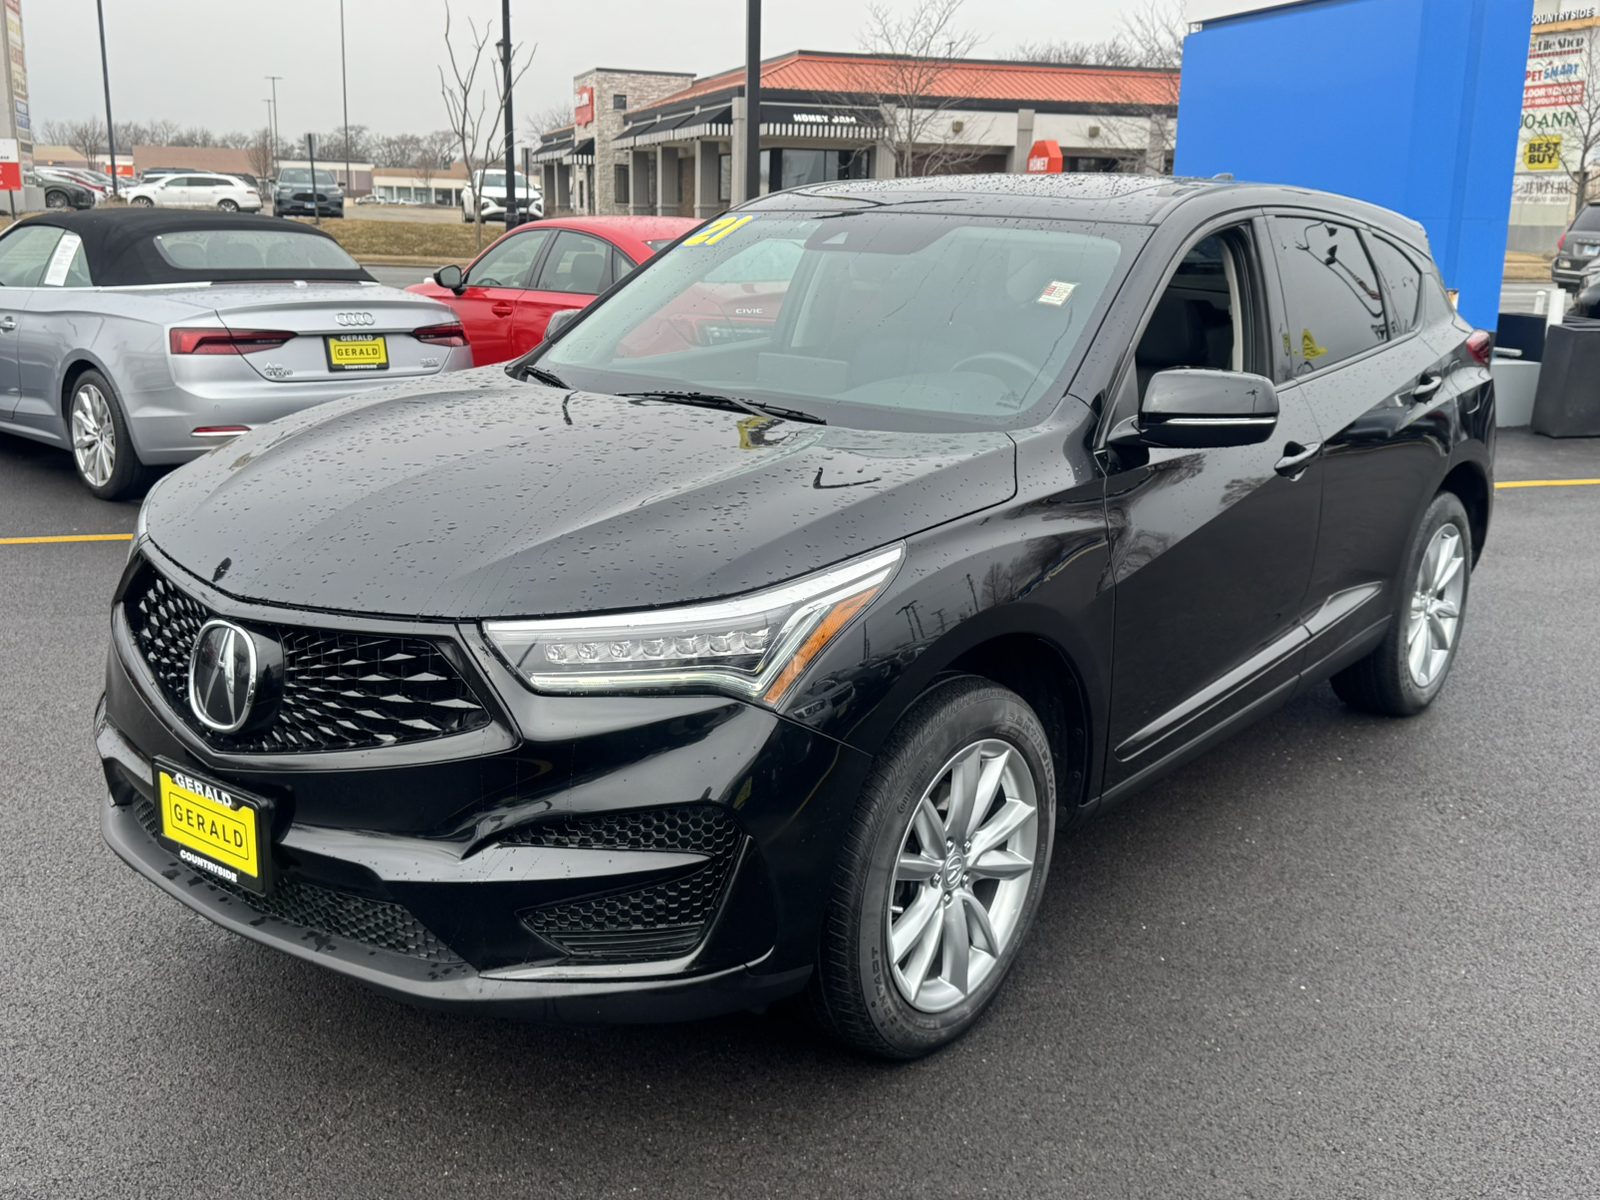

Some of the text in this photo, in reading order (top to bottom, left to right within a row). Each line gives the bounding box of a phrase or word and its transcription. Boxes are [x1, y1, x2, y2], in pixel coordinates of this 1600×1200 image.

[1557, 37, 1584, 50] Shop
[1523, 87, 1547, 99] LOOR
[793, 113, 829, 124] HONEY
[1528, 142, 1561, 153] BEST
[1528, 152, 1556, 164] BUY
[340, 334, 373, 342] GERALD
[337, 347, 379, 357] GERALD
[174, 772, 232, 807] GERALD
[173, 803, 244, 848] GERALD
[179, 849, 238, 883] COUNTRYSIDE
